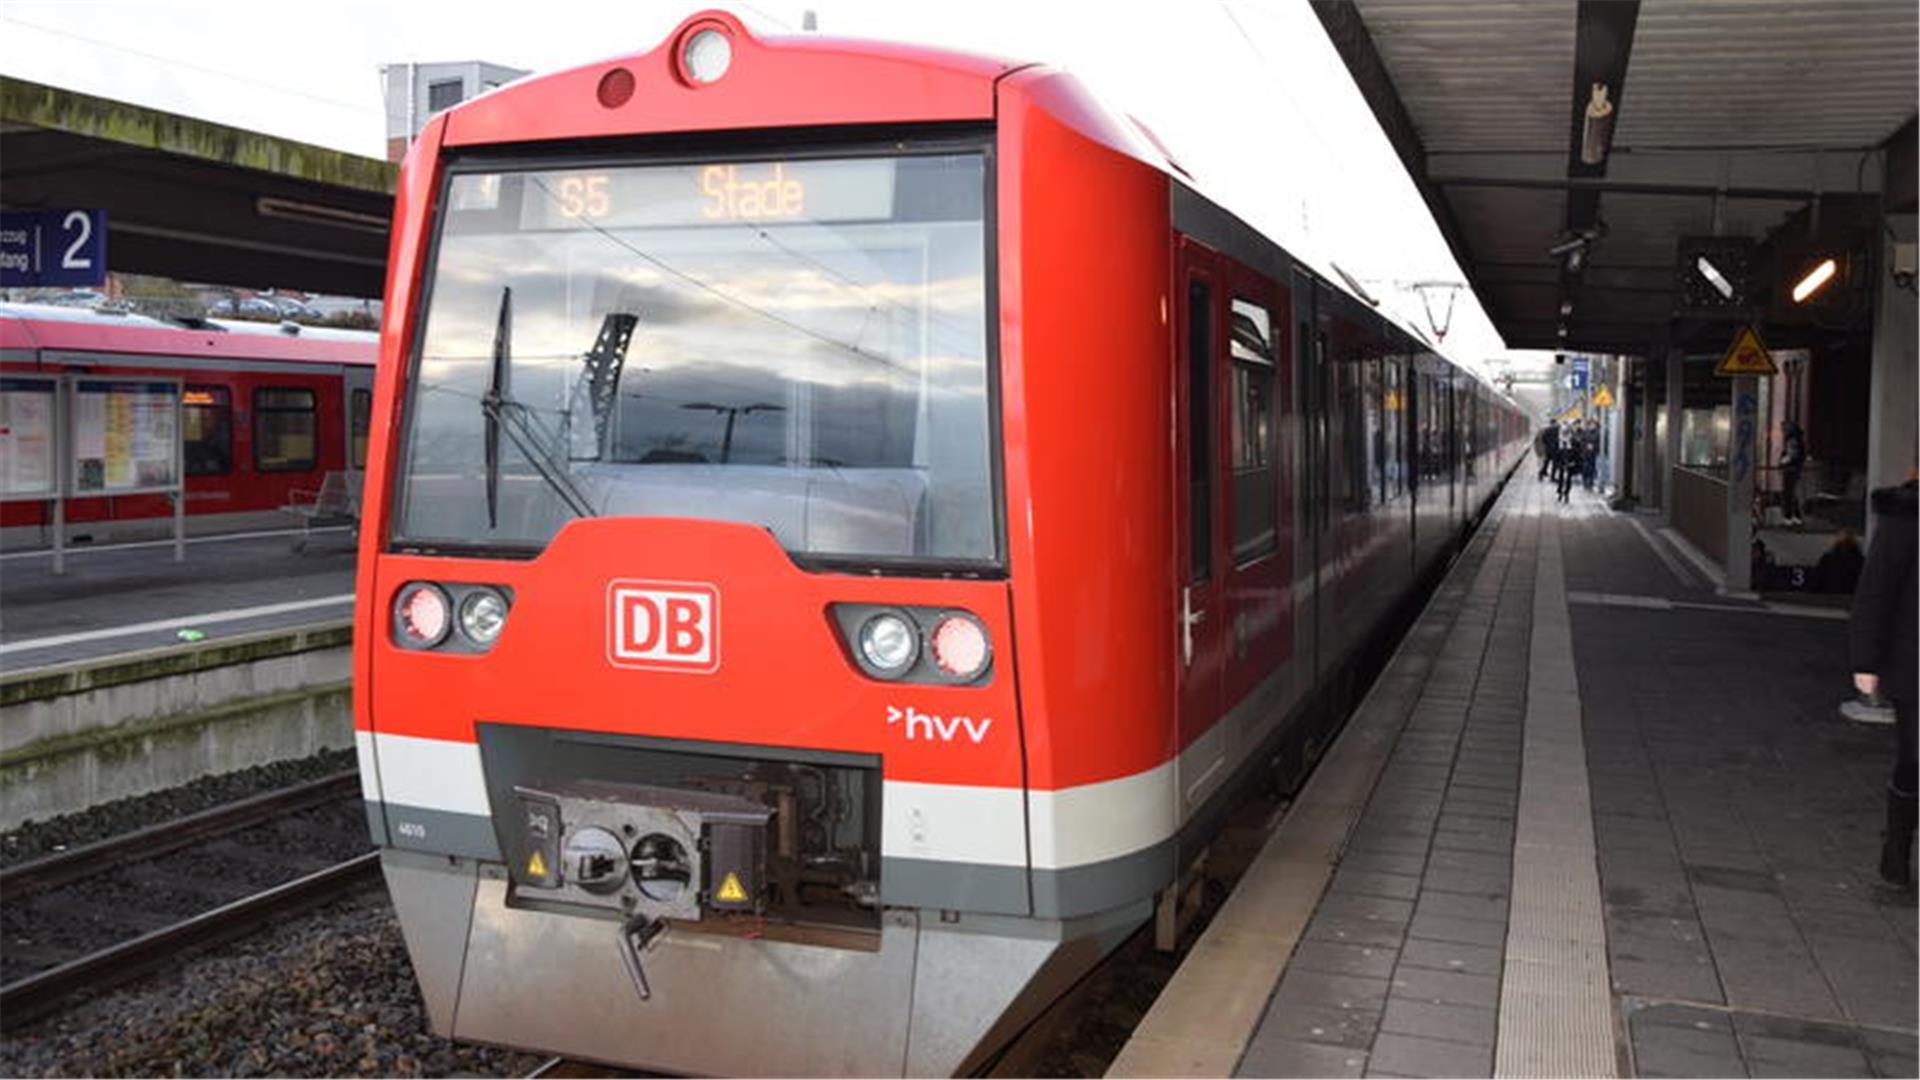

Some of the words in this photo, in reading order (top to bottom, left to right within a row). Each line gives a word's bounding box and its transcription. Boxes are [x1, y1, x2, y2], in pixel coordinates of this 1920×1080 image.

[559, 175, 611, 218] S5
[703, 163, 804, 218] Stade
[62, 210, 92, 269] 2
[1791, 567, 1806, 587] 3
[622, 595, 705, 656] DB
